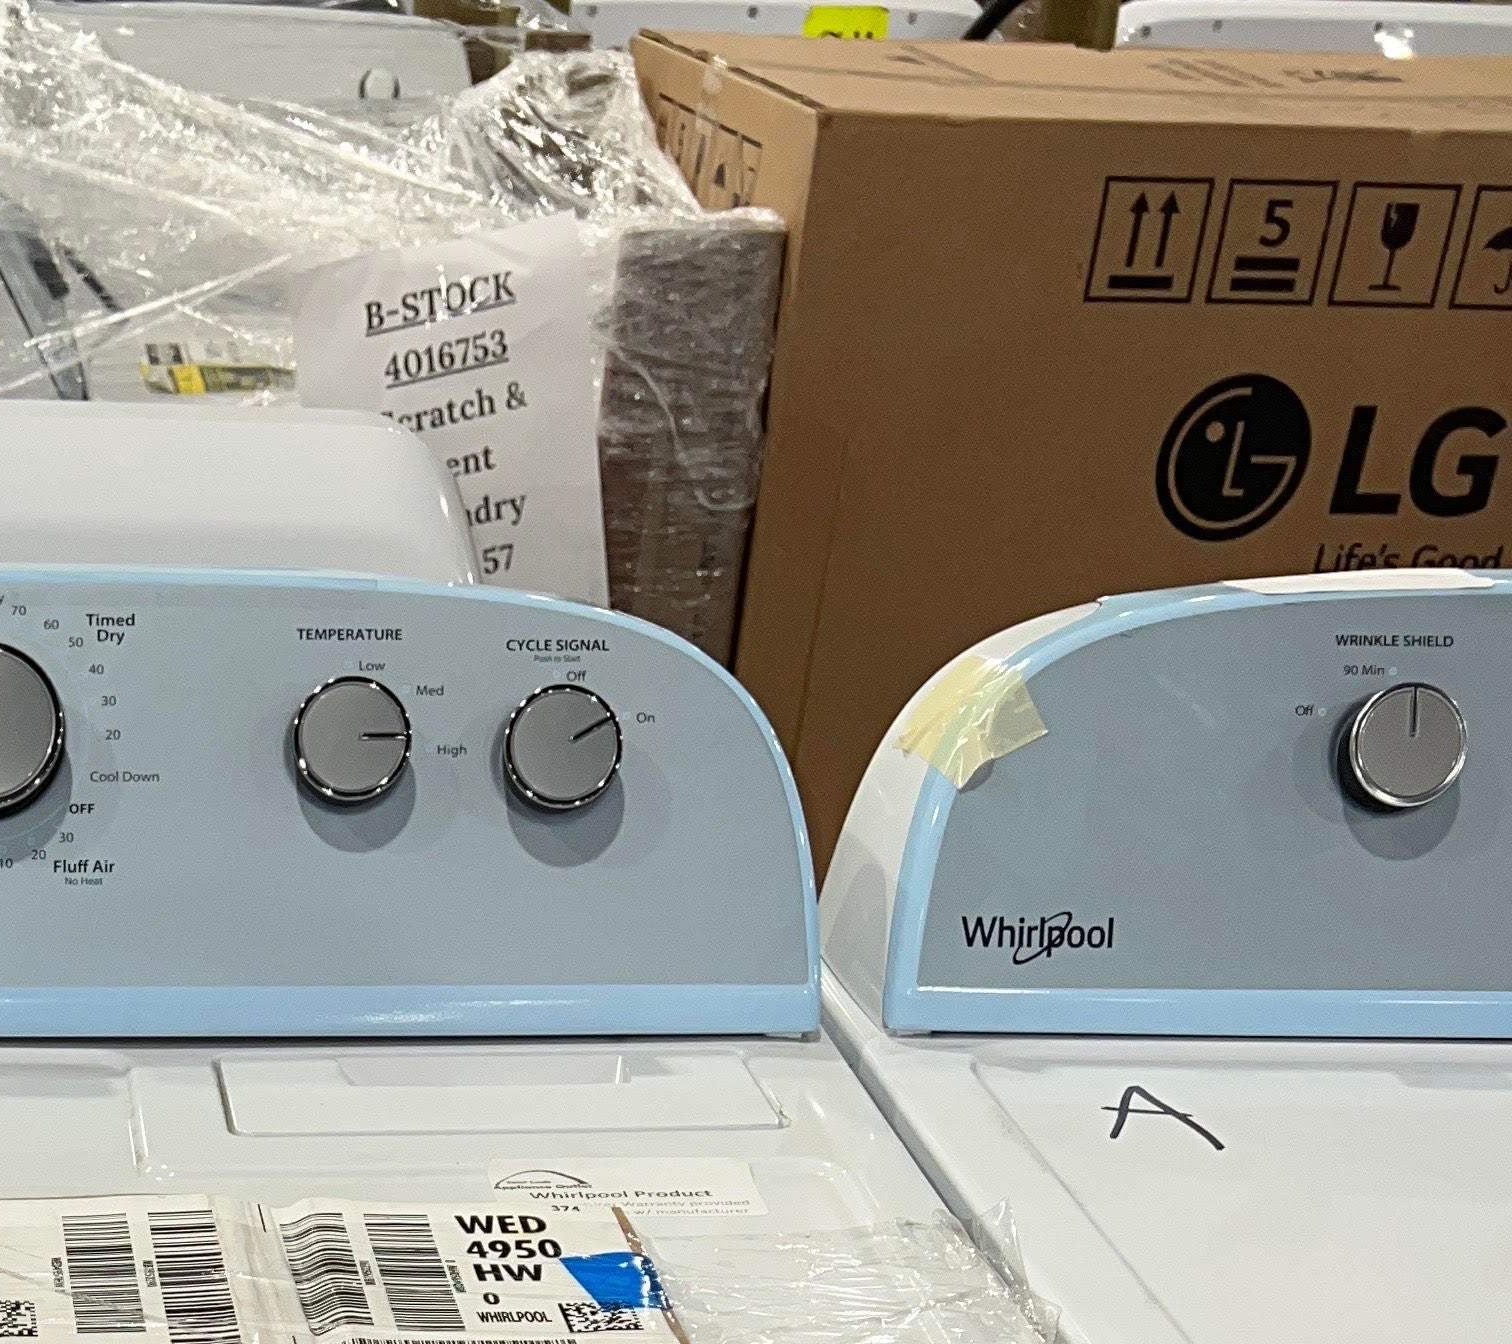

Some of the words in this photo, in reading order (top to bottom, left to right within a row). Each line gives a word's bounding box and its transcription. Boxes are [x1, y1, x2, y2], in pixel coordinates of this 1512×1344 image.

[365, 271, 517, 332] B-STOCK
[384, 328, 509, 381] 4016753
[506, 381, 529, 410] &
[1329, 405, 1507, 517] LG
[482, 543, 515, 574] 57
[11, 605, 27, 616] 70
[44, 619, 60, 630] 60
[86, 613, 136, 628] Timed
[97, 629, 126, 646] Dry
[297, 628, 403, 641] TEMPERATURE
[1335, 634, 1399, 647] WRINKLE
[1403, 634, 1454, 647] SHIELD
[68, 637, 84, 648] 50
[506, 640, 552, 652] CYCLE
[556, 640, 610, 652] SIGNAL
[88, 664, 104, 675] 40
[358, 660, 386, 672] Low
[1343, 664, 1358, 676] 90
[1361, 664, 1385, 676] Min
[566, 670, 586, 682] Off
[416, 684, 444, 697] Med
[101, 695, 117, 706] 30
[1294, 704, 1315, 717] Off
[636, 712, 655, 723] On
[105, 729, 121, 740] 20
[437, 743, 467, 757] High
[90, 771, 118, 783] Cool
[122, 771, 160, 783] Down
[69, 804, 95, 815] OFF
[58, 832, 74, 844] 30
[31, 849, 47, 861] 20
[0, 858, 13, 869] 10
[54, 860, 88, 875] Fluff
[91, 860, 115, 874] Air
[65, 877, 78, 886] No
[80, 877, 103, 886] Heat
[961, 912, 1115, 964] Whirlpool
[1100, 1085, 1226, 1150] A
[530, 1190, 628, 1200] Whirlpool
[634, 1190, 713, 1198] Product
[454, 1215, 546, 1234] WED
[466, 1239, 562, 1259] 4950
[473, 1264, 542, 1282] HW
[483, 1292, 500, 1305] 0
[477, 1311, 552, 1323] WHIRLPOOL
